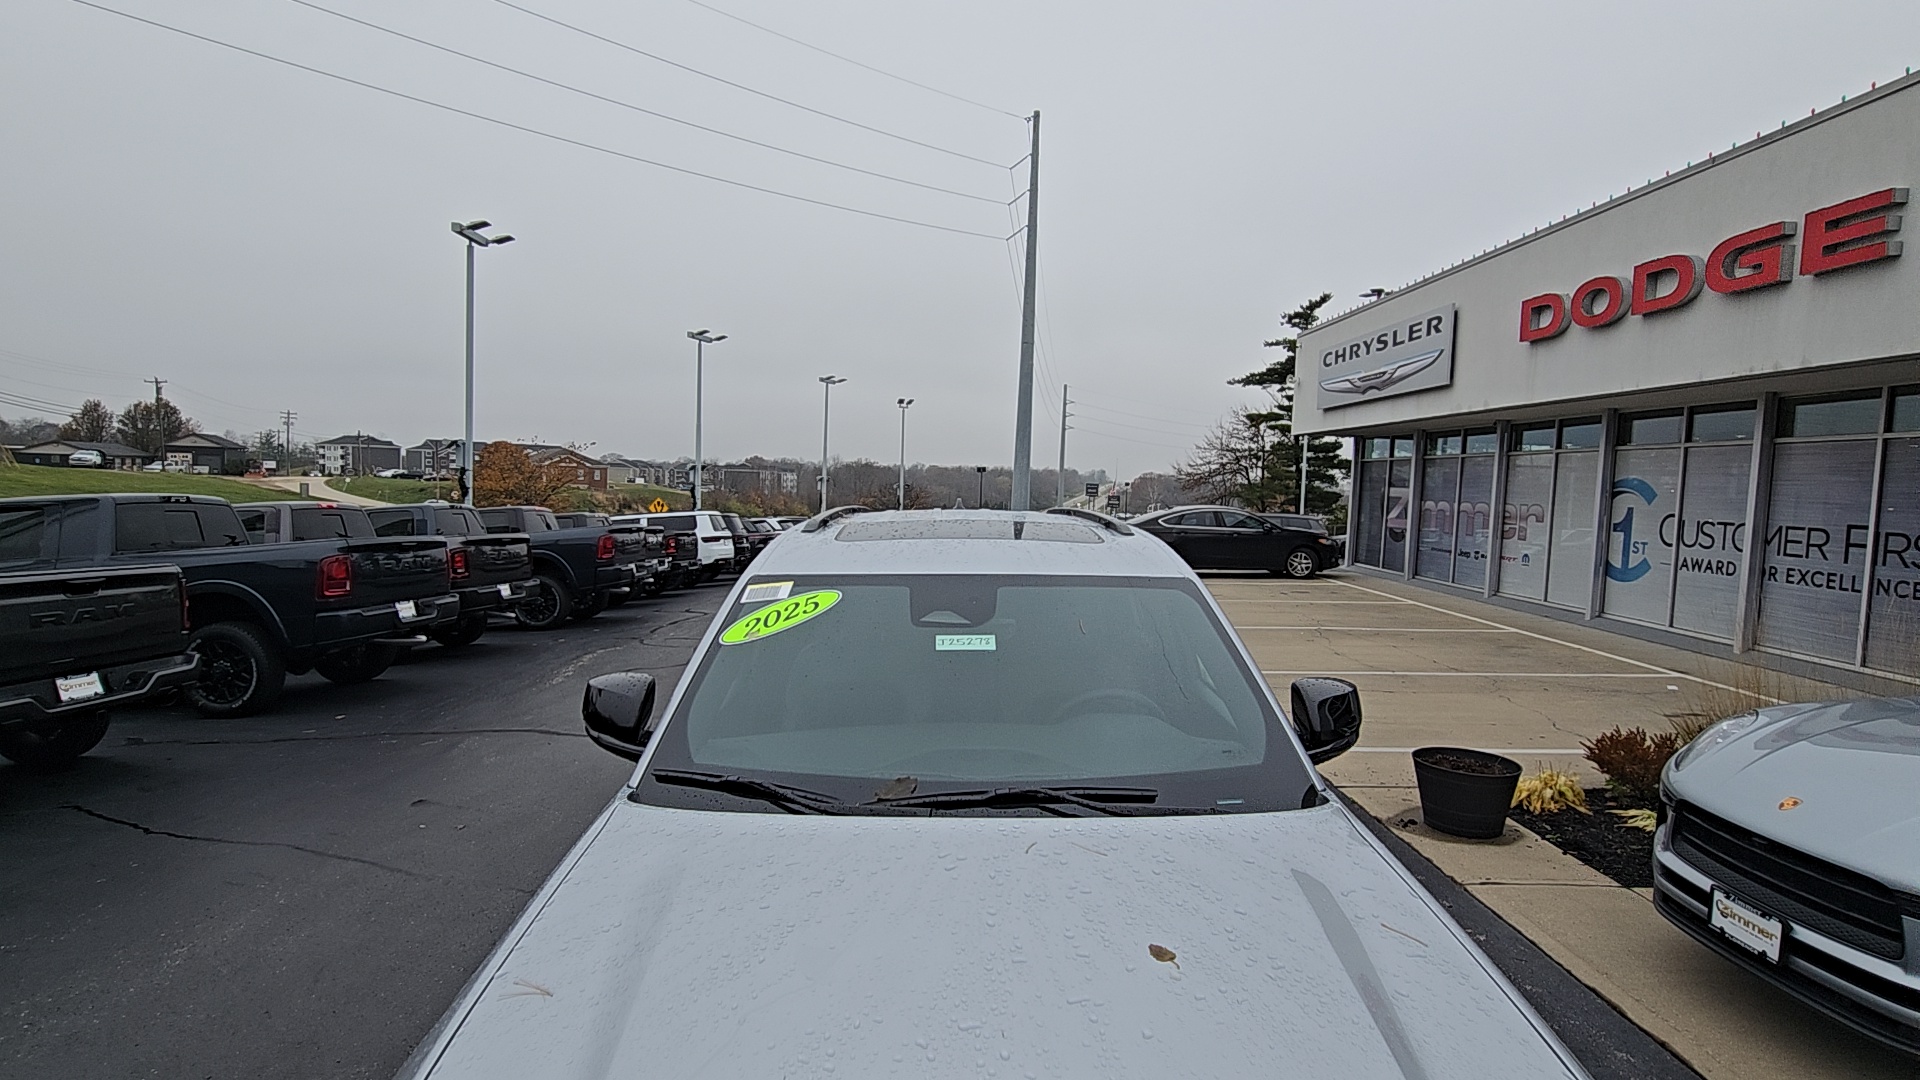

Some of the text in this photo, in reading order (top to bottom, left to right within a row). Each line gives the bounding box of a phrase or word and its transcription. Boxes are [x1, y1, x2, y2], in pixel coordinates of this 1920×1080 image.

[1519, 188, 1908, 342] DODGE
[1322, 315, 1443, 368] CHRYSLER
[1387, 487, 1545, 541] Zmmer
[1679, 556, 1737, 577] AWARD
[1785, 567, 1920, 601] EXCELLNCE
[30, 602, 135, 632] RAM
[743, 594, 820, 639] 2025
